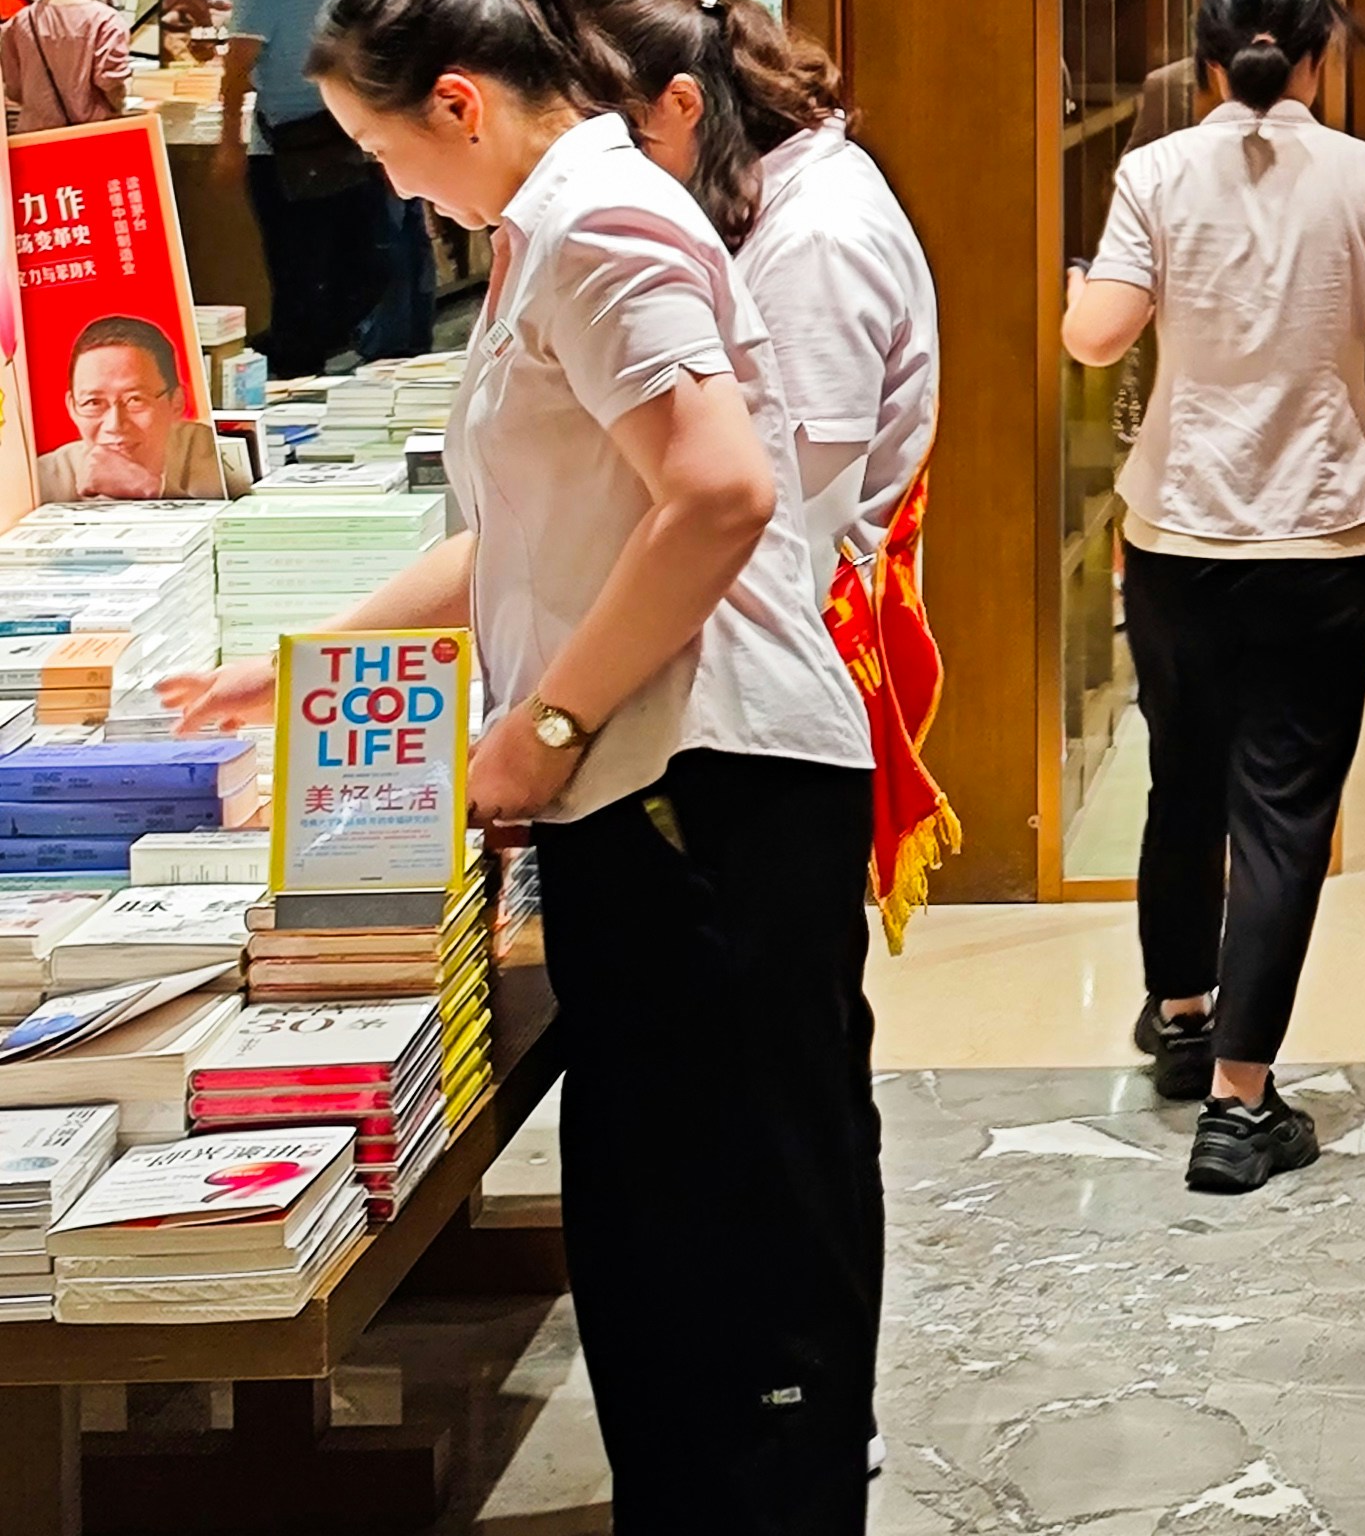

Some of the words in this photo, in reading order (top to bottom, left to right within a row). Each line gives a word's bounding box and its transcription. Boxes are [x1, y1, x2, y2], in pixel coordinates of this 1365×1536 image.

[320, 644, 427, 683] THE
[302, 685, 445, 727] GOOD
[317, 728, 427, 768] LIFE
[304, 782, 440, 815] 美好生活
